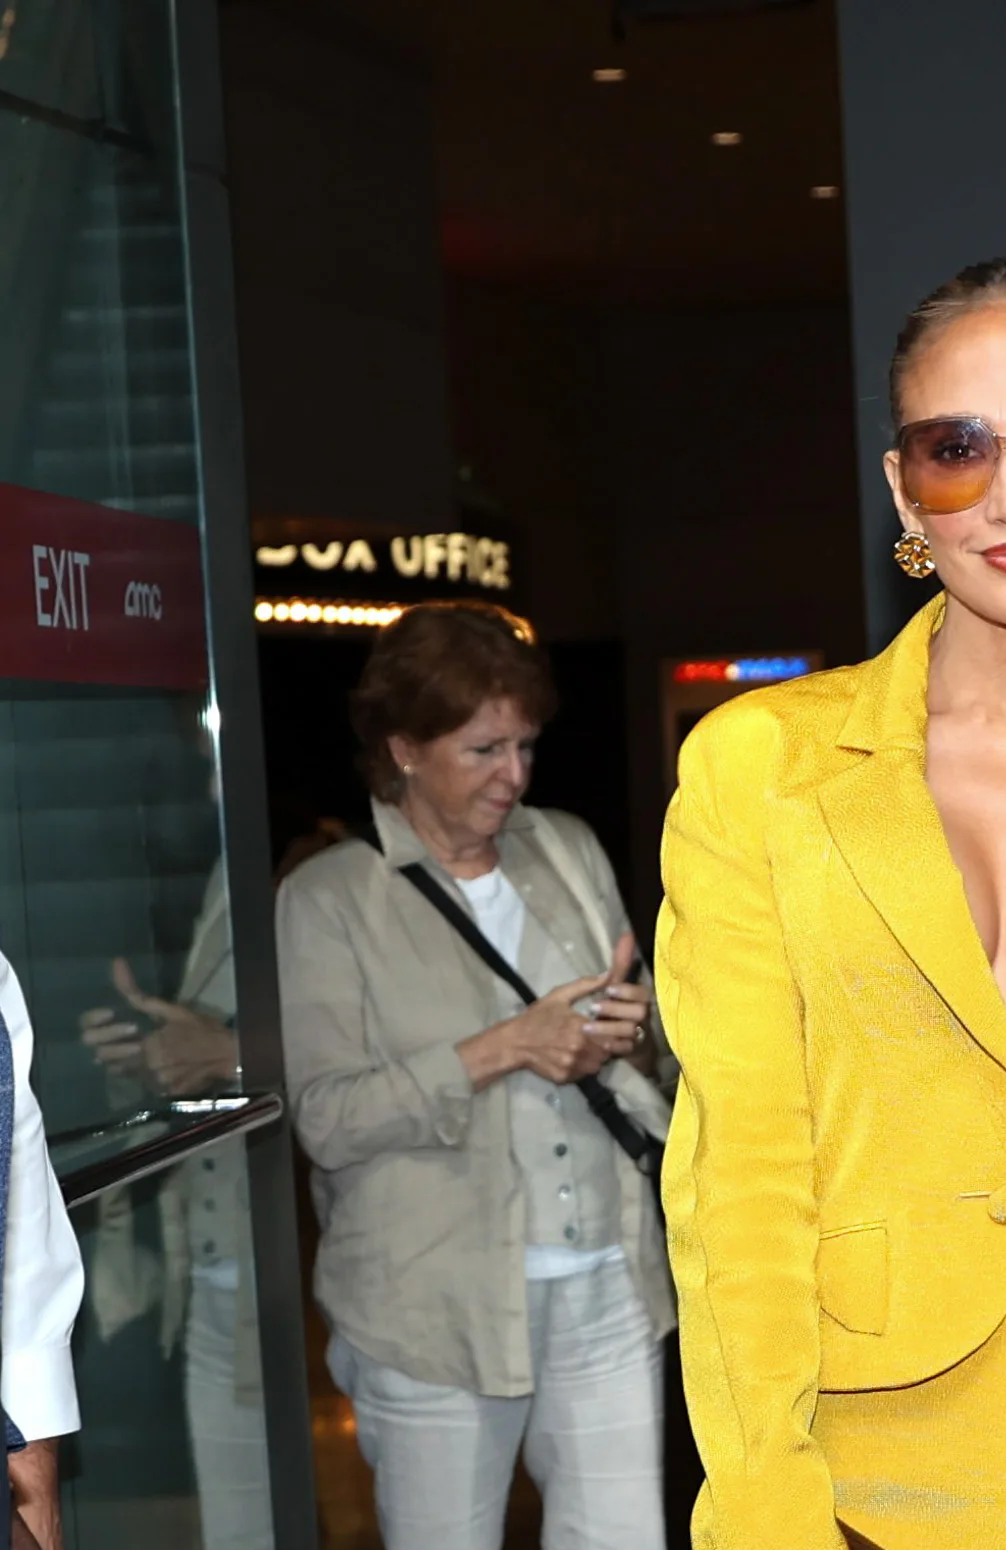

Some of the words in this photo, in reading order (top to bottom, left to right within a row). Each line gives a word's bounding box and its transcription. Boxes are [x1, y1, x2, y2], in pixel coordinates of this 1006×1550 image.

[32, 544, 90, 631] EXIT
[391, 532, 510, 590] OFFICE
[124, 580, 162, 621] amc
